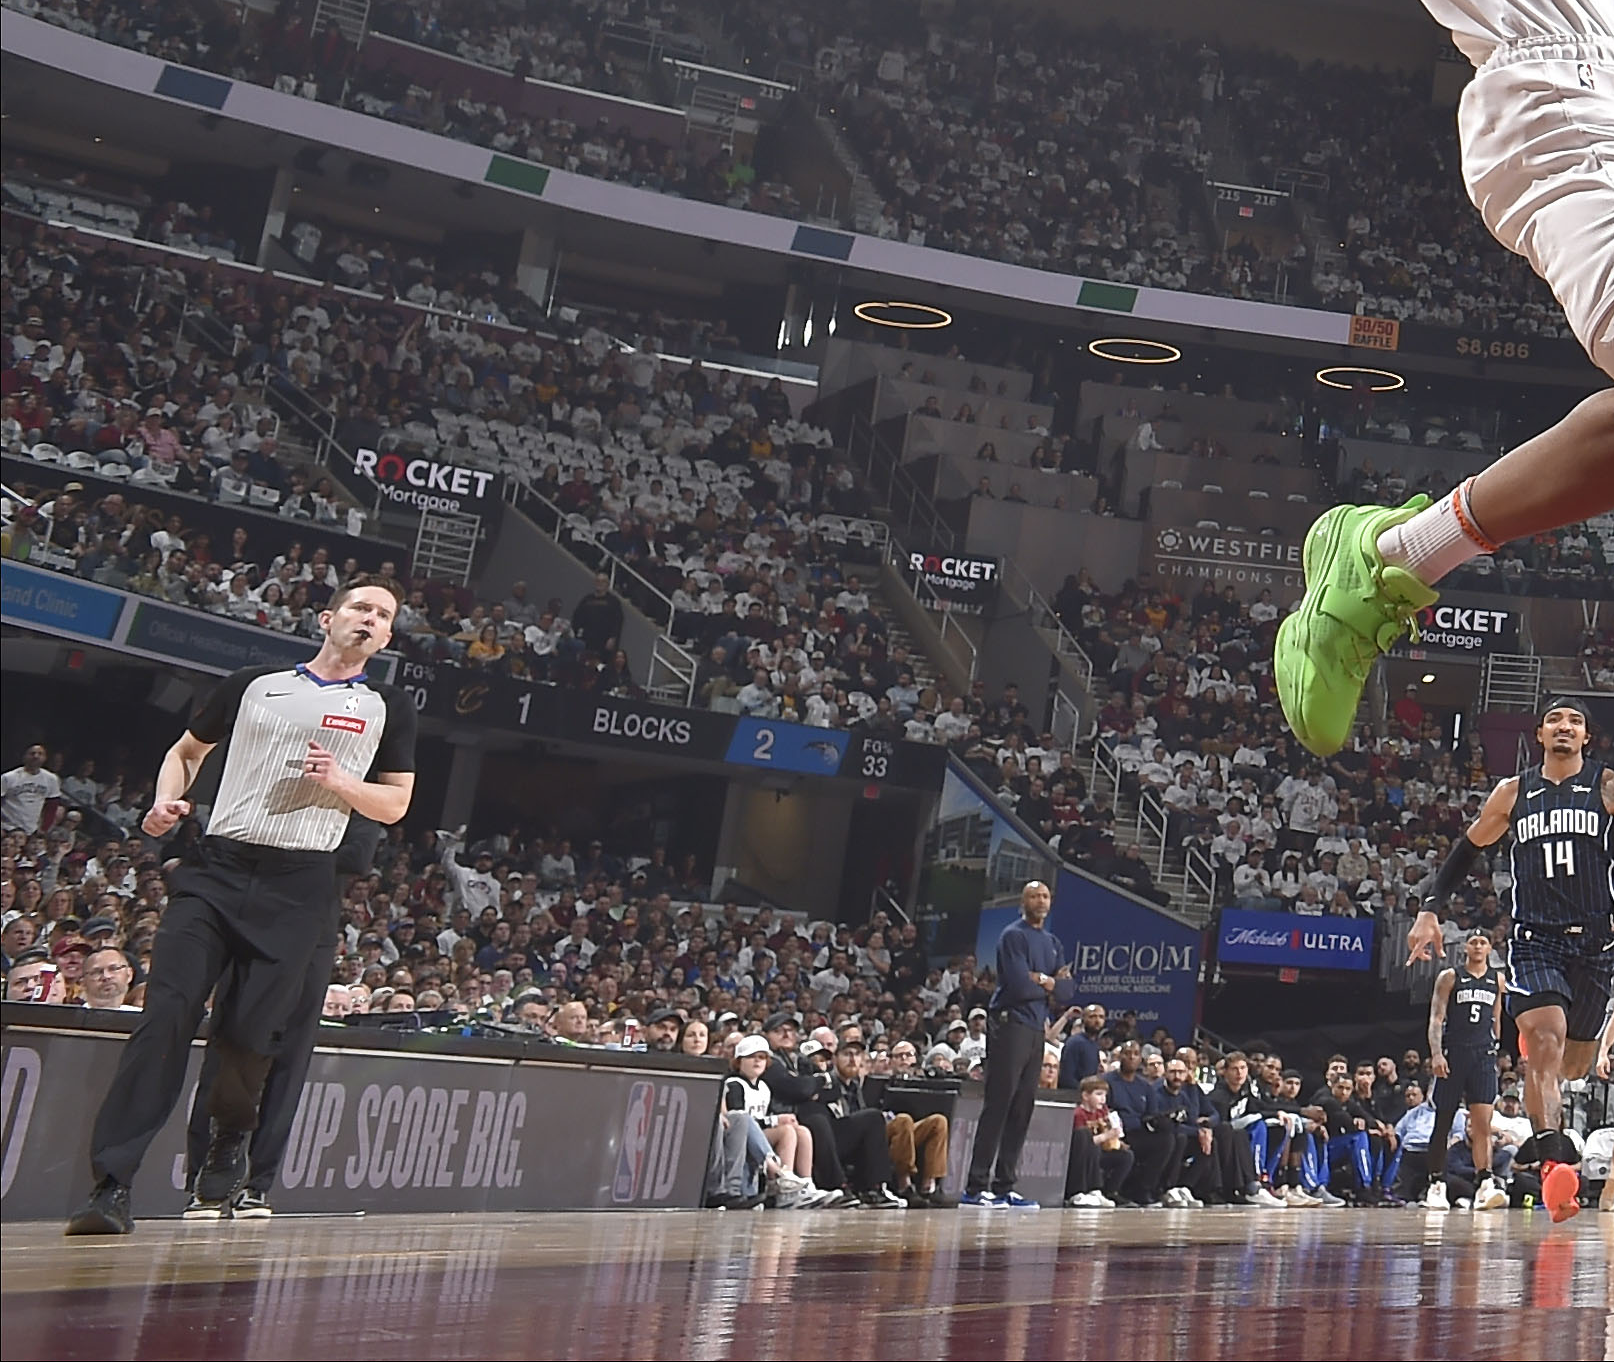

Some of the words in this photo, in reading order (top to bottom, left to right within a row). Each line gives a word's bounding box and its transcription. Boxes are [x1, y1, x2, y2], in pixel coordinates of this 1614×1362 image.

[1353, 320, 1394, 337] 50/50
[1353, 335, 1392, 349] RAFFLE
[1456, 338, 1529, 359] $8,686
[354, 449, 493, 498] ROCKET
[1188, 536, 1300, 561] WESTFIE
[909, 553, 995, 580] ROCKET
[1158, 563, 1272, 584] CHAMPIONS
[925, 573, 976, 590] Mortgage
[1418, 630, 1482, 649] Mortgage
[403, 662, 435, 681] FG%
[519, 693, 531, 724] 1
[593, 709, 691, 744] BLOCKS
[754, 729, 774, 760] 2
[862, 755, 888, 777] 33
[1517, 808, 1599, 844] ORLANDO
[1542, 841, 1575, 878] 14
[1225, 928, 1288, 946] Michelob
[1303, 933, 1364, 951] ULTRA
[1080, 945, 1191, 972] ECOM
[1457, 989, 1496, 1006] ORLANDO
[1470, 1004, 1480, 1023] 5
[283, 1081, 345, 1189] UP.
[351, 1085, 467, 1189] SCORE
[462, 1089, 528, 1188] BIG.
[642, 1085, 688, 1200] iD
